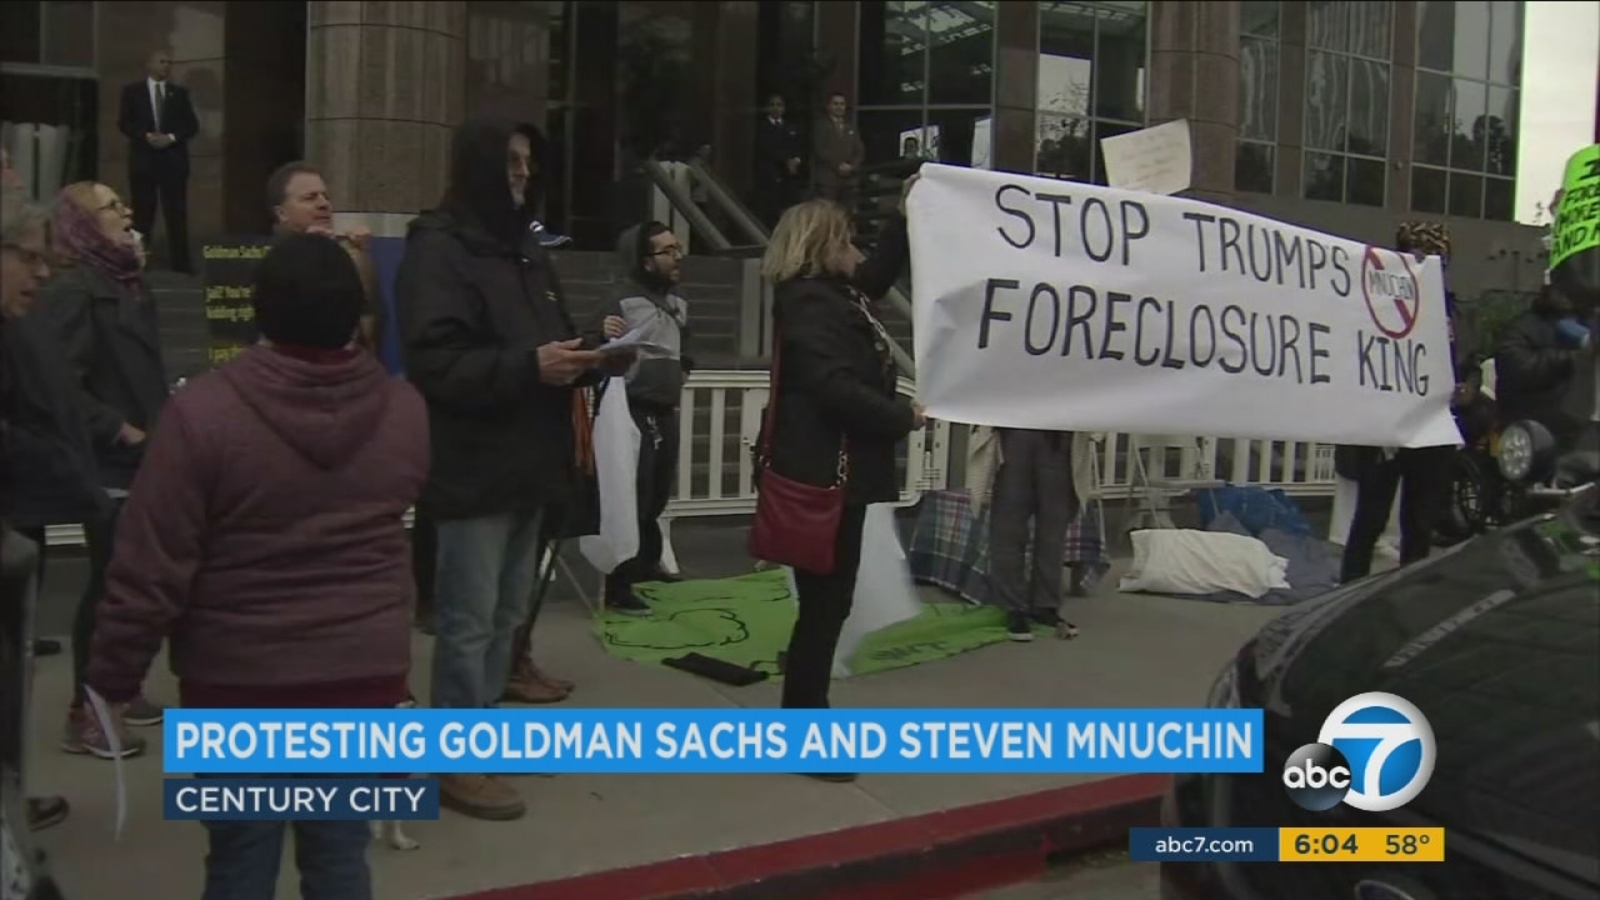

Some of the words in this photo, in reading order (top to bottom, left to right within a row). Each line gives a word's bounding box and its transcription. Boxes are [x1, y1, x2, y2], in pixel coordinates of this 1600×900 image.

[995, 184, 1150, 266] STOP
[1183, 211, 1352, 298] TRUMP'S
[978, 278, 1332, 385] FORECLOSURE
[1358, 329, 1429, 396] KING
